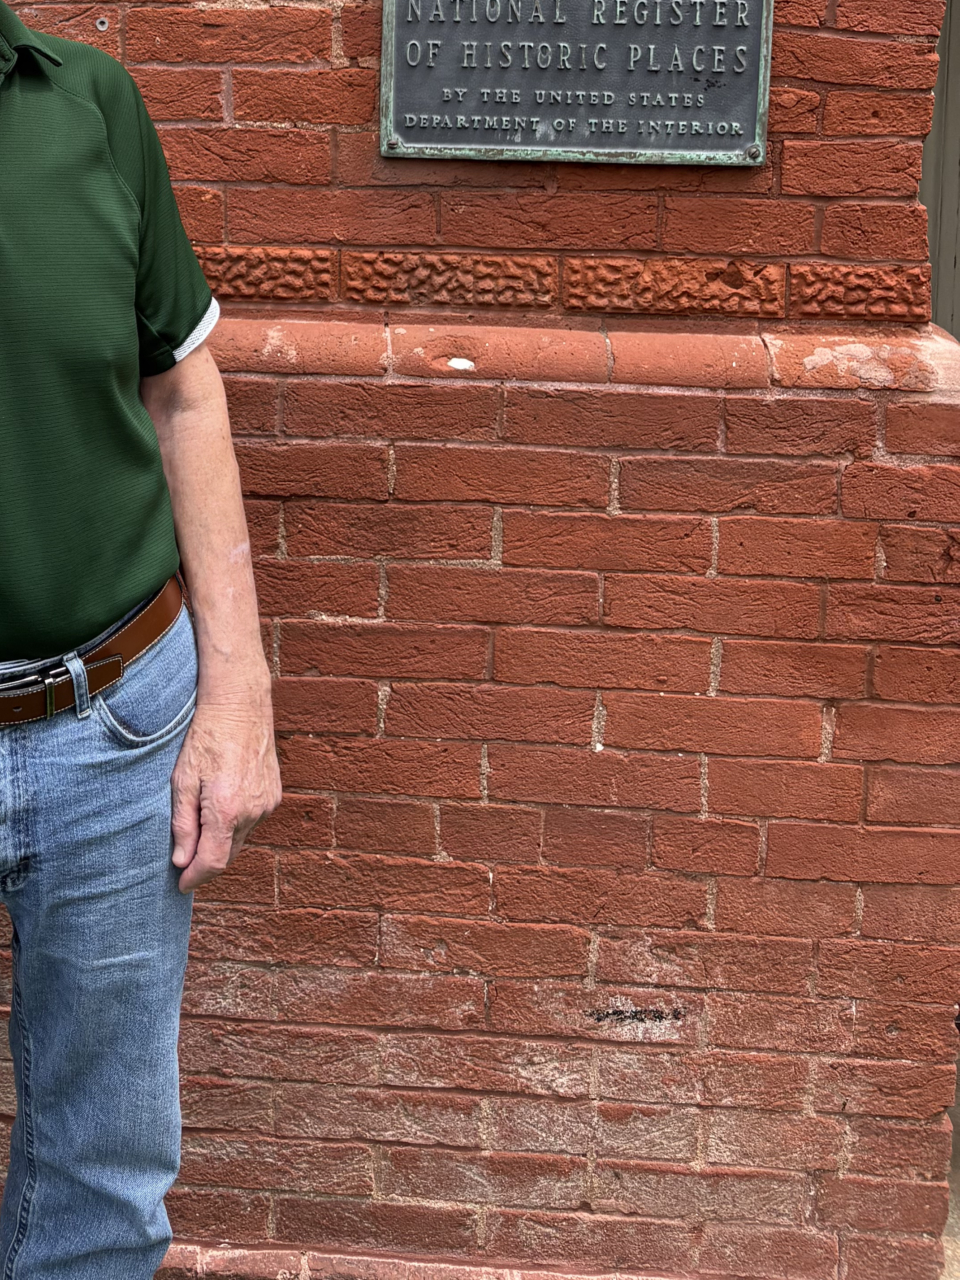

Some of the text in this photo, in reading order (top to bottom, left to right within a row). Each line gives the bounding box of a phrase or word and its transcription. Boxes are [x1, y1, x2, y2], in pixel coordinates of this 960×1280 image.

[406, 41, 747, 74] OF HISTORIC PLACES
[443, 88, 704, 107] BY THE UNITED STATES
[405, 114, 744, 136] DEPARTMENT OF THE INTERIOR
